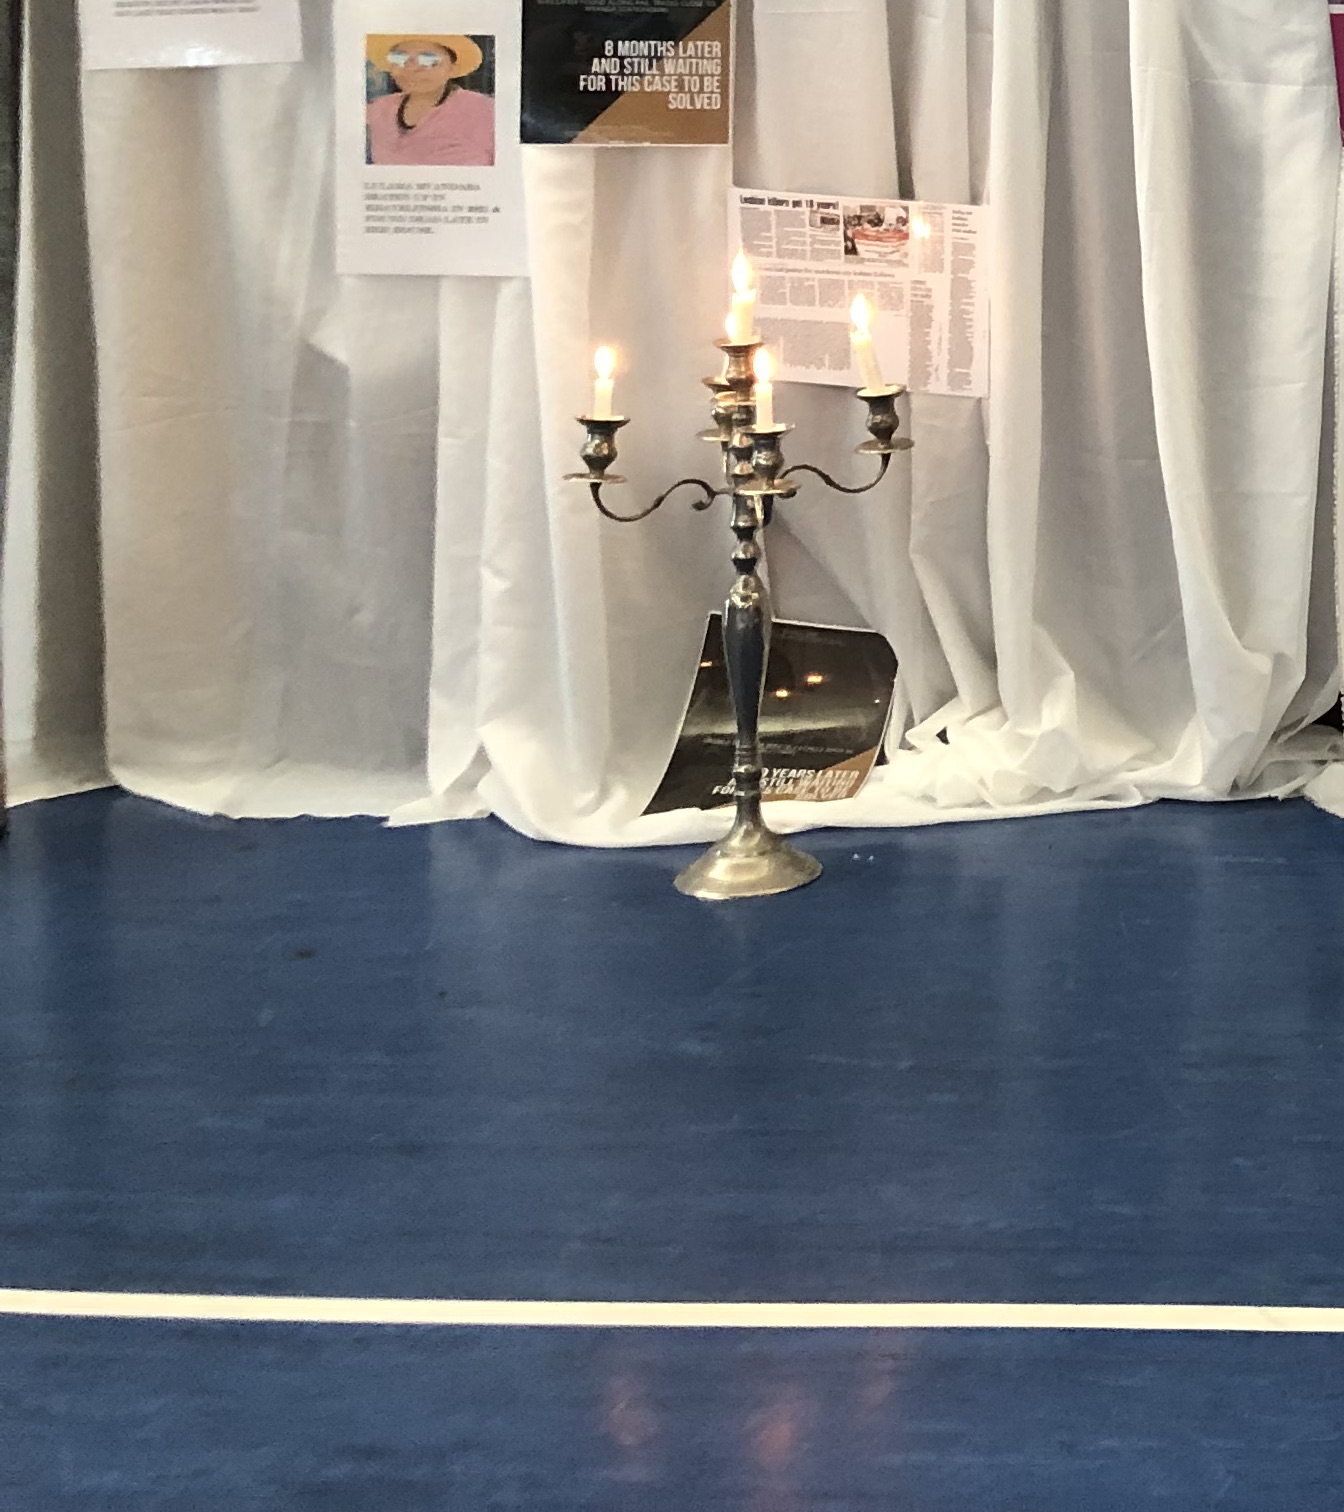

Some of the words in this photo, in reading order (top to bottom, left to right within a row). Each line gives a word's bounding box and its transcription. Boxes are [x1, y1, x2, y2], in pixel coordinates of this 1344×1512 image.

[604, 40, 614, 57] 8
[617, 40, 675, 57] MONTHS
[678, 40, 722, 58] LATER
[591, 58, 620, 74] AND
[623, 58, 659, 75] STILL
[663, 58, 722, 75] WAITING
[579, 75, 606, 92] FOR
[610, 75, 641, 92] THIS
[643, 75, 677, 92] CASE
[680, 76, 700, 93] TO
[703, 76, 722, 93] BE
[667, 93, 722, 110] SOLVED
[771, 769, 815, 778] YEARS
[815, 769, 859, 780] LATER
